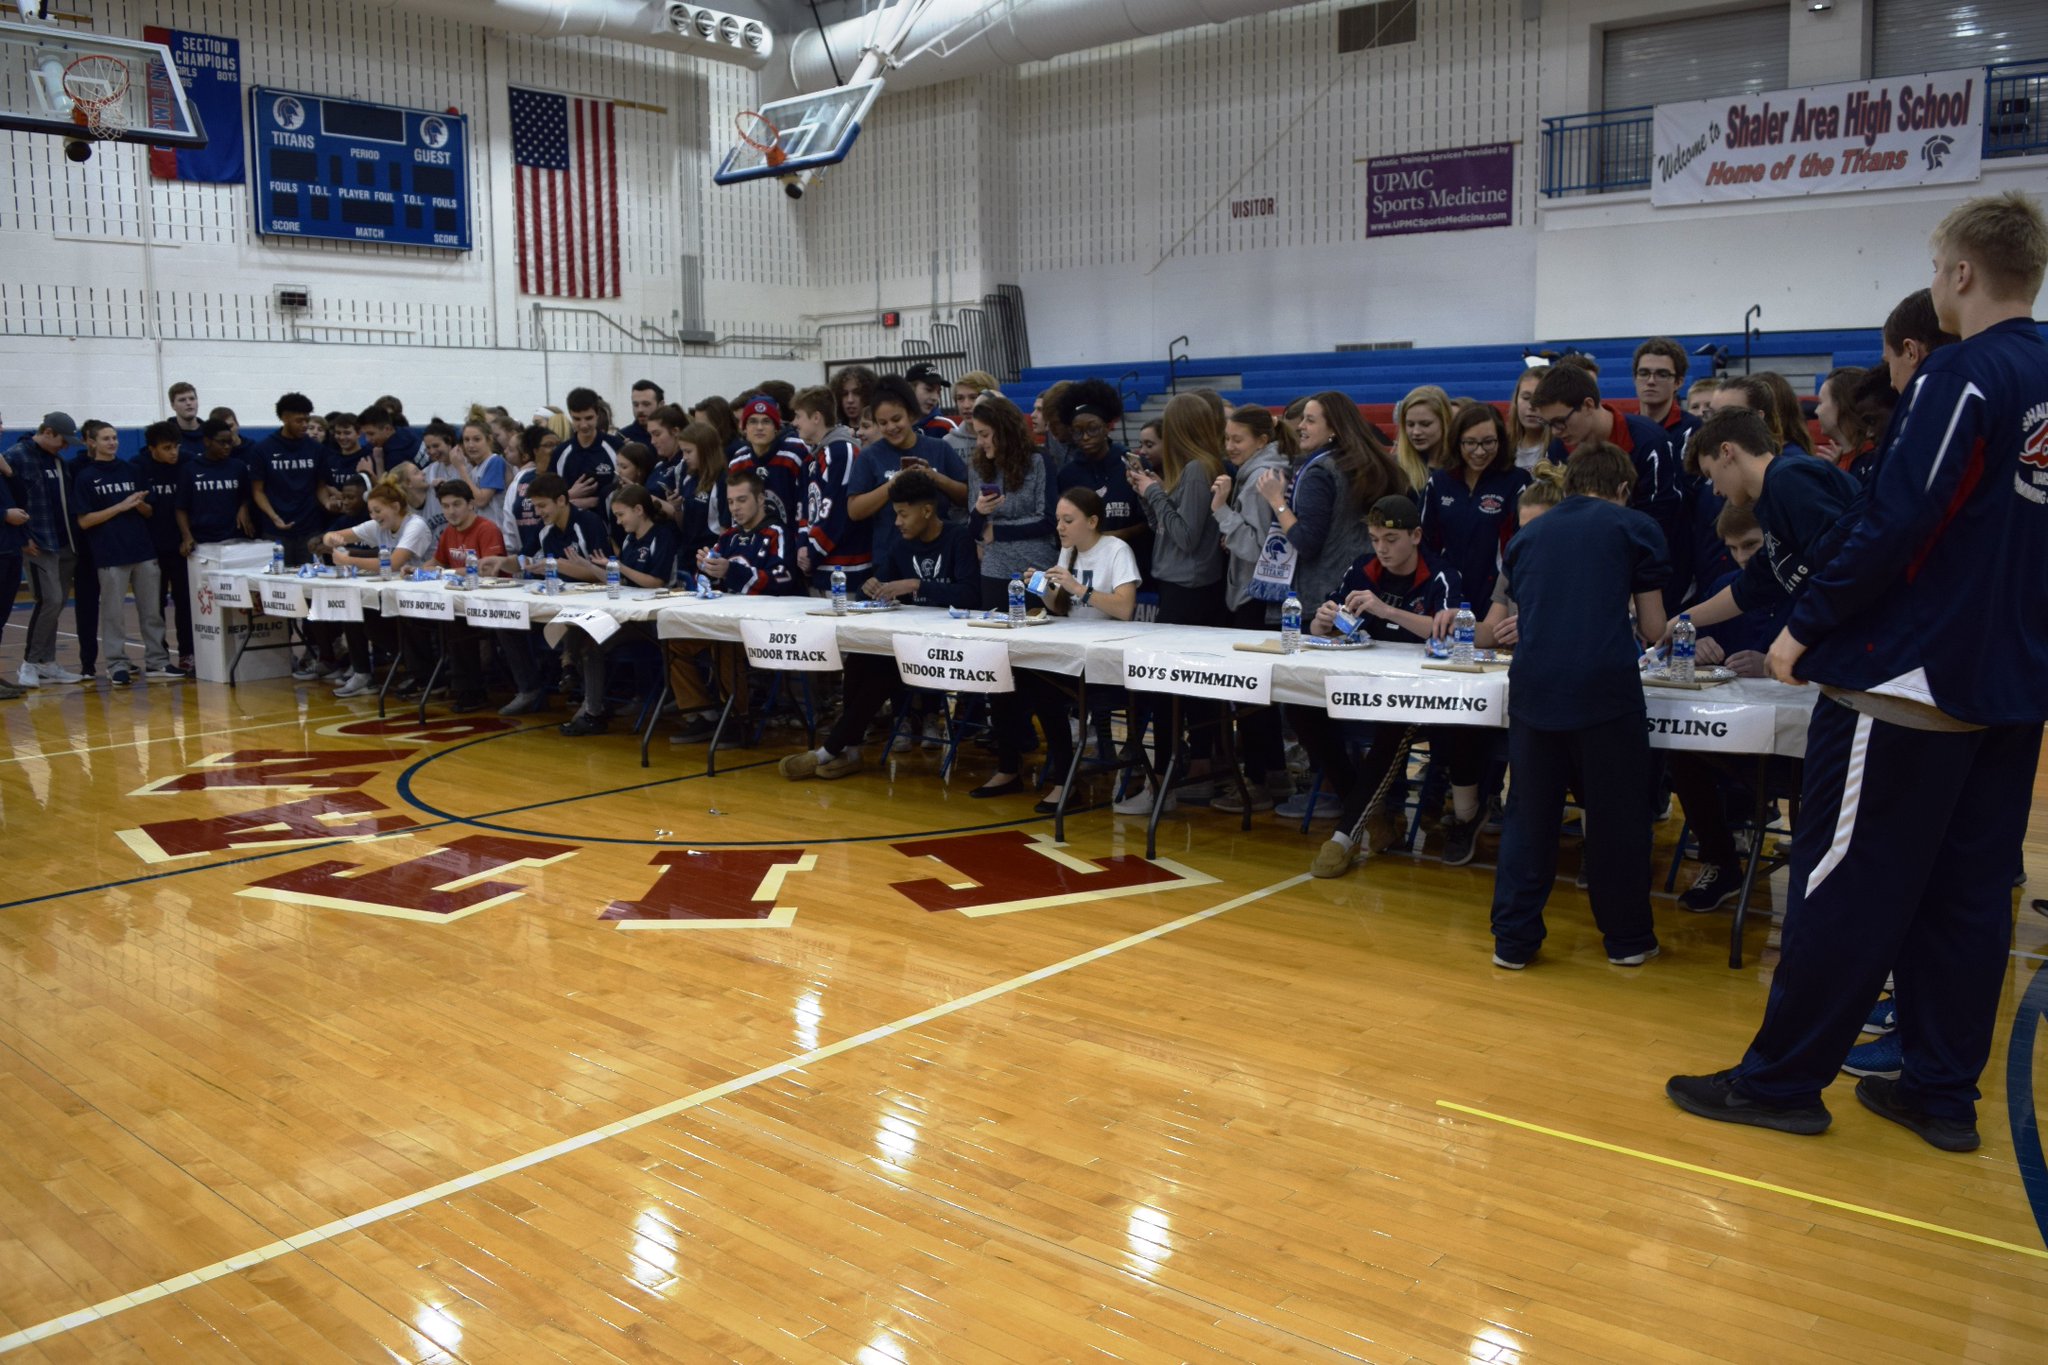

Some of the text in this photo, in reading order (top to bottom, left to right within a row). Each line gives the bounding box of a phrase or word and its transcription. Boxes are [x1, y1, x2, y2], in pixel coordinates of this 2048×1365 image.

[182, 36, 228, 55] SECTION
[175, 50, 236, 70] CHAMPIONS
[217, 71, 237, 82] BOYS
[1725, 78, 1973, 149] Shaler Area High School
[271, 131, 315, 149] TITANS
[350, 147, 380, 160] PERIOD
[414, 148, 451, 165] GUEST
[1431, 151, 1462, 160] Services
[1463, 146, 1498, 157] Provided
[1499, 145, 1509, 155] by
[1658, 120, 1720, 183] Welcome to
[1705, 147, 1909, 186] Home of the Titans
[1372, 168, 1434, 193] UPMC
[269, 181, 457, 209] FOULS T.O.L. PLAYER FOUL T.O.L. FOULS
[1372, 185, 1508, 218] Sports Medicine
[1231, 197, 1275, 219] VISITOR
[1370, 212, 1508, 231] www.UPMCSportsMedicine.com
[271, 220, 459, 245] SCORE MATCH SCORE
[271, 459, 315, 470] TITANS
[95, 481, 135, 495] TITANS
[195, 479, 239, 491] TITANS
[1105, 501, 1130, 510] AREA
[263, 601, 296, 611] BASKETBALL
[327, 599, 346, 609] BOCCE
[398, 599, 445, 612] BOYS BOWLING
[466, 607, 521, 620] GIRLS BOWLING
[195, 623, 220, 634] REPUBLIC
[768, 632, 797, 645] BOYS
[748, 648, 827, 662] INDOOR TRACK
[927, 648, 964, 662] GIRLS
[902, 662, 997, 682] INDOOR TRACK
[1127, 664, 1258, 690] BOYS SWIMMING
[1331, 691, 1488, 712] GIRLS SWIMMING
